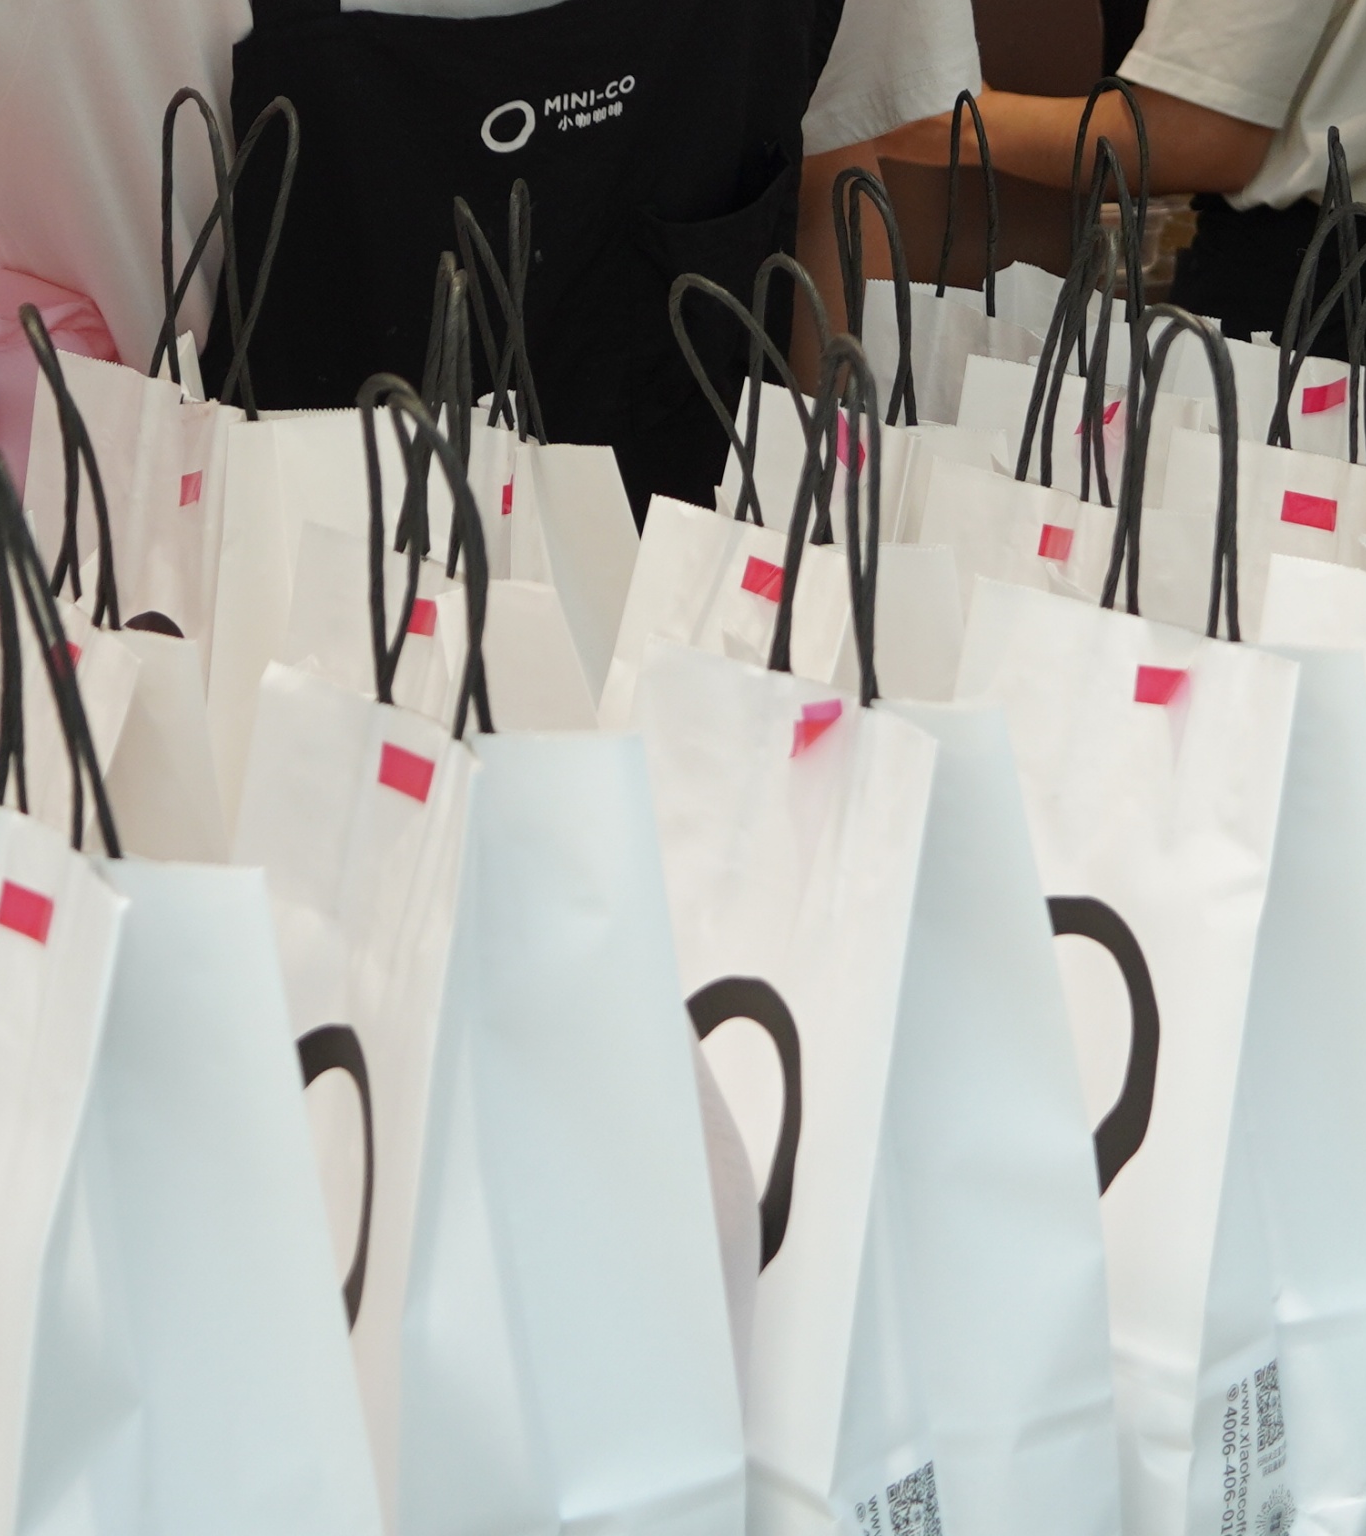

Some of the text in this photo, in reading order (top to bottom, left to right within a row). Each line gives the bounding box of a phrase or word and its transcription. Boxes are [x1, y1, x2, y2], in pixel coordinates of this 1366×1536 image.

[544, 75, 635, 116] MINI-CO
[1221, 1407, 1237, 1536] 4006-406-01
[1235, 1377, 1251, 1536] www.xiaokacoff
